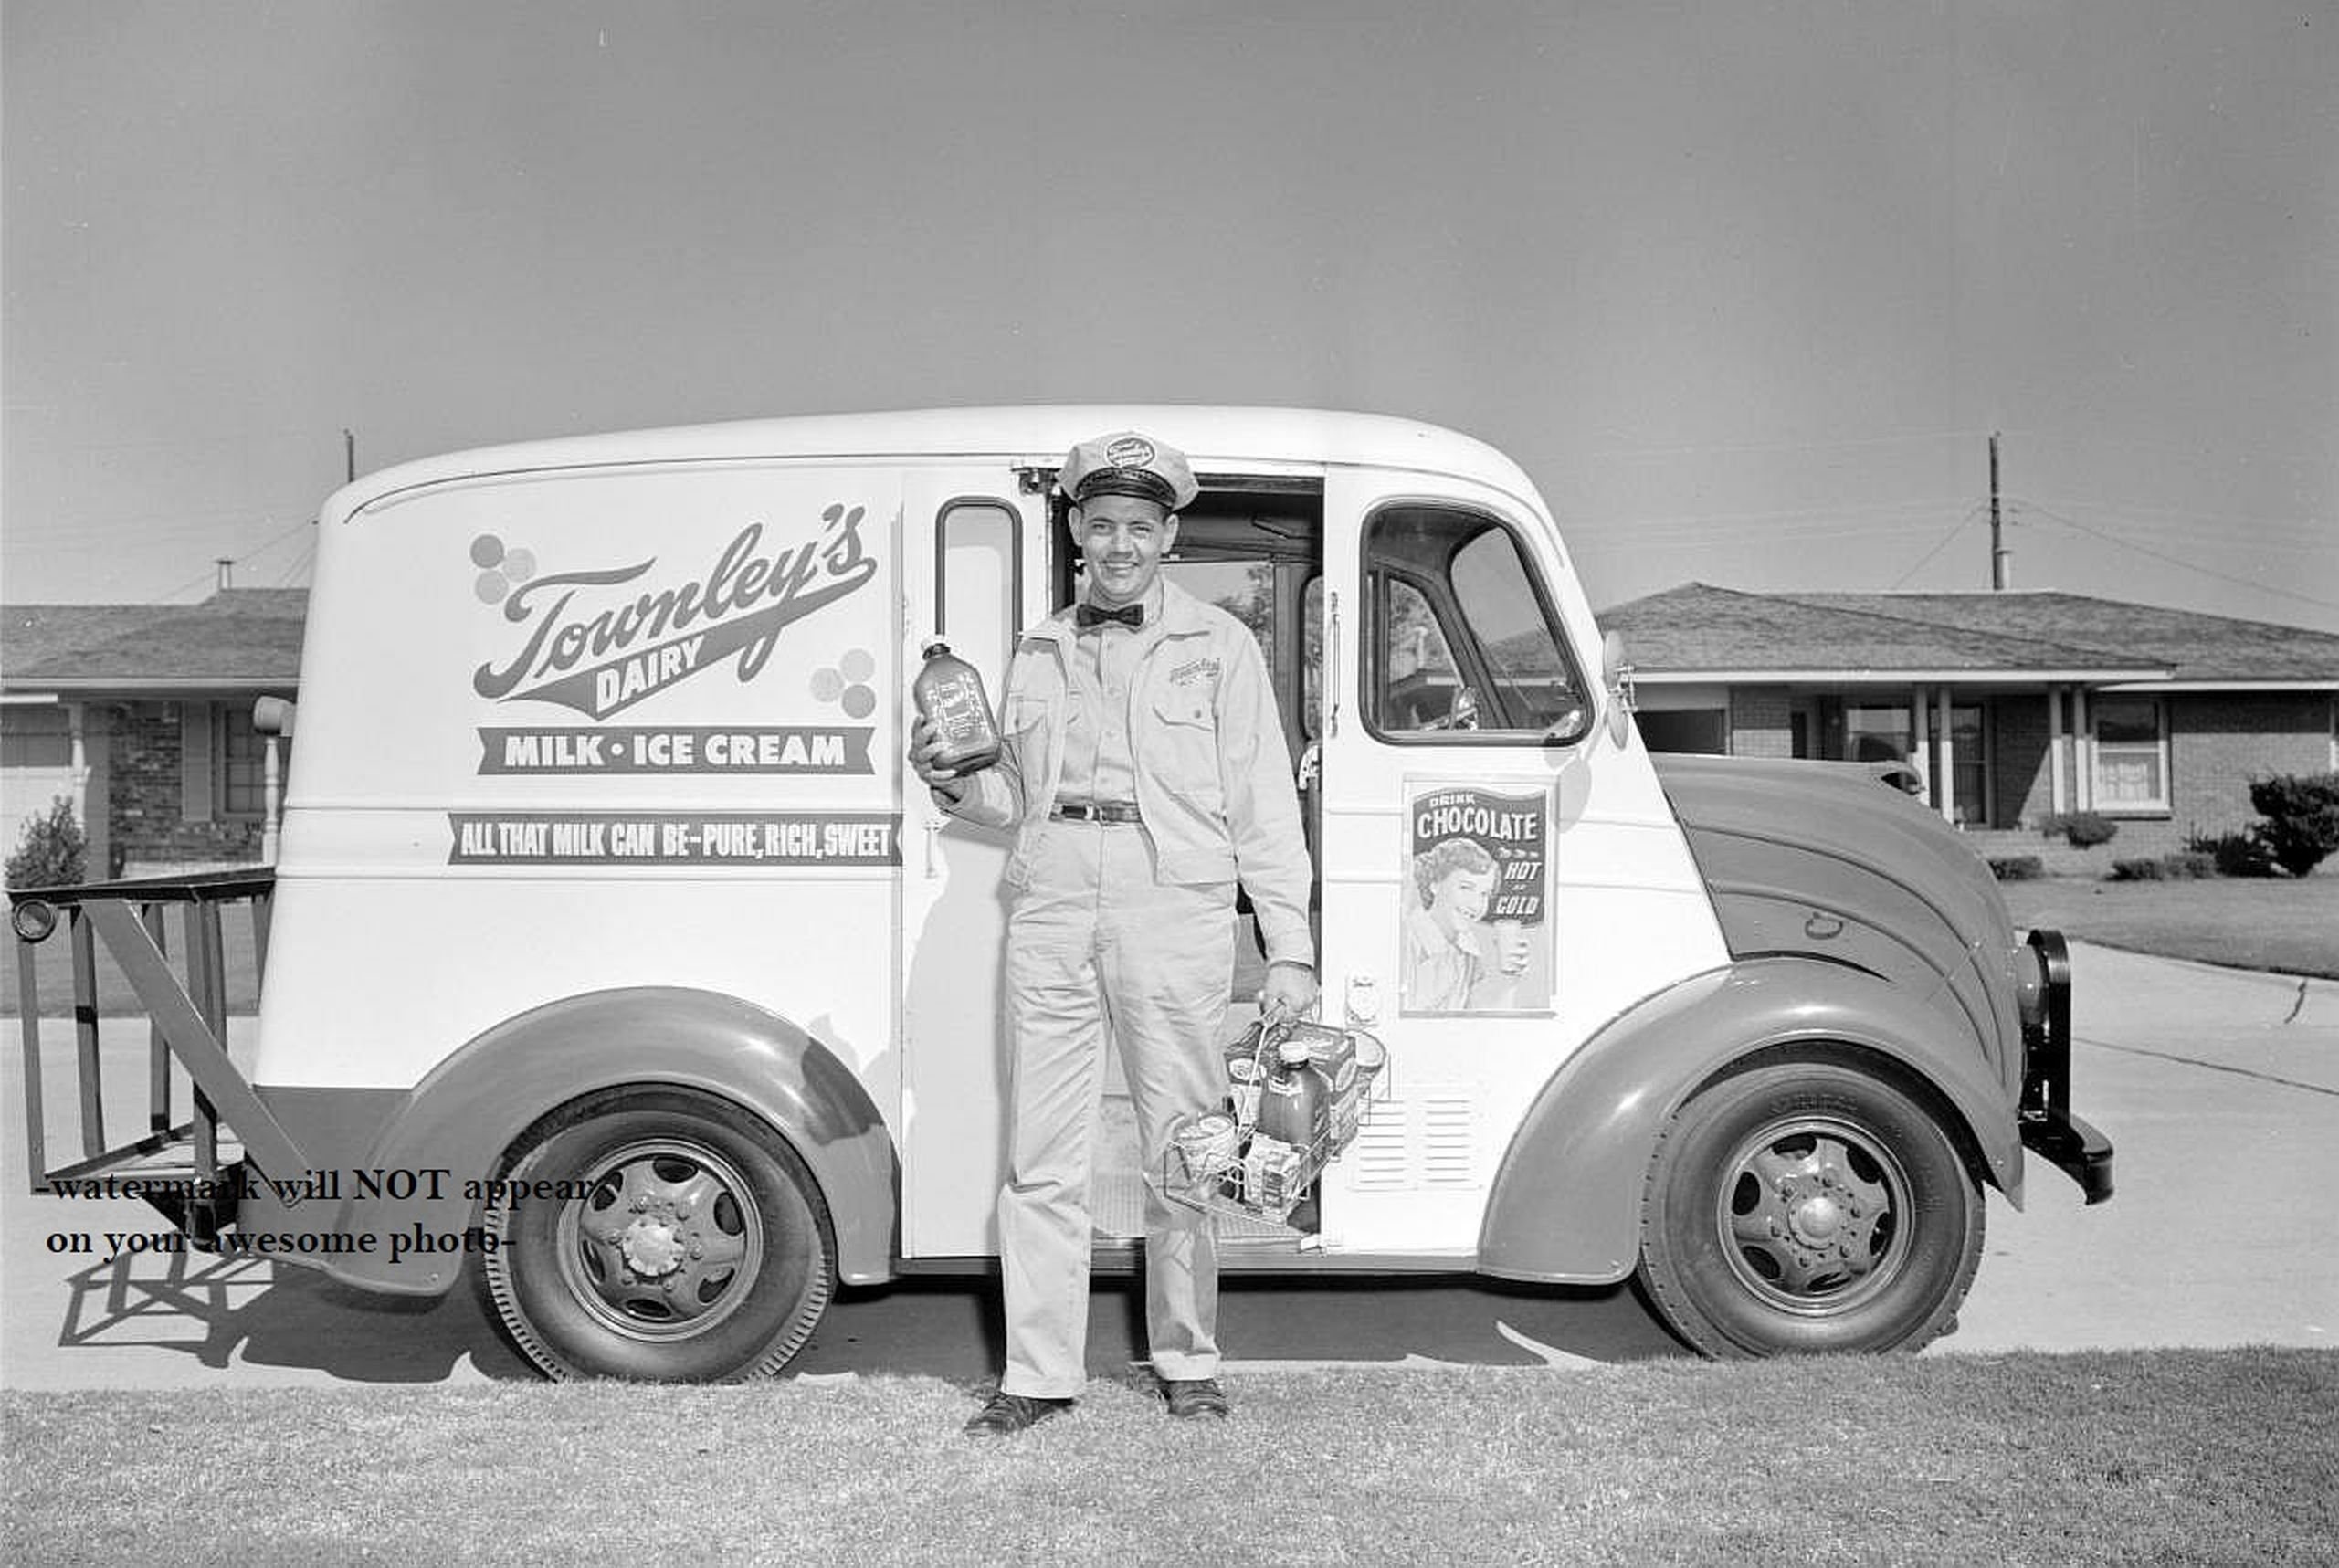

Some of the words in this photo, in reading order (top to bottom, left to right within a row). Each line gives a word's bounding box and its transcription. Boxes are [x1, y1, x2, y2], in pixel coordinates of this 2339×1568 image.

[473, 503, 878, 699] Townley's
[596, 634, 705, 714] DAIRY
[504, 734, 605, 767] MILK
[633, 733, 695, 767] ICE
[704, 733, 846, 767] CREAM
[1429, 794, 1475, 806] DRINK
[1417, 806, 1536, 839] CHOCOLATE
[460, 822, 498, 857] ALL
[498, 822, 549, 857] THAT
[552, 822, 606, 857] MILK
[610, 822, 658, 857] CAN
[1504, 860, 1543, 881] HOT
[1496, 895, 1541, 915] COLD
